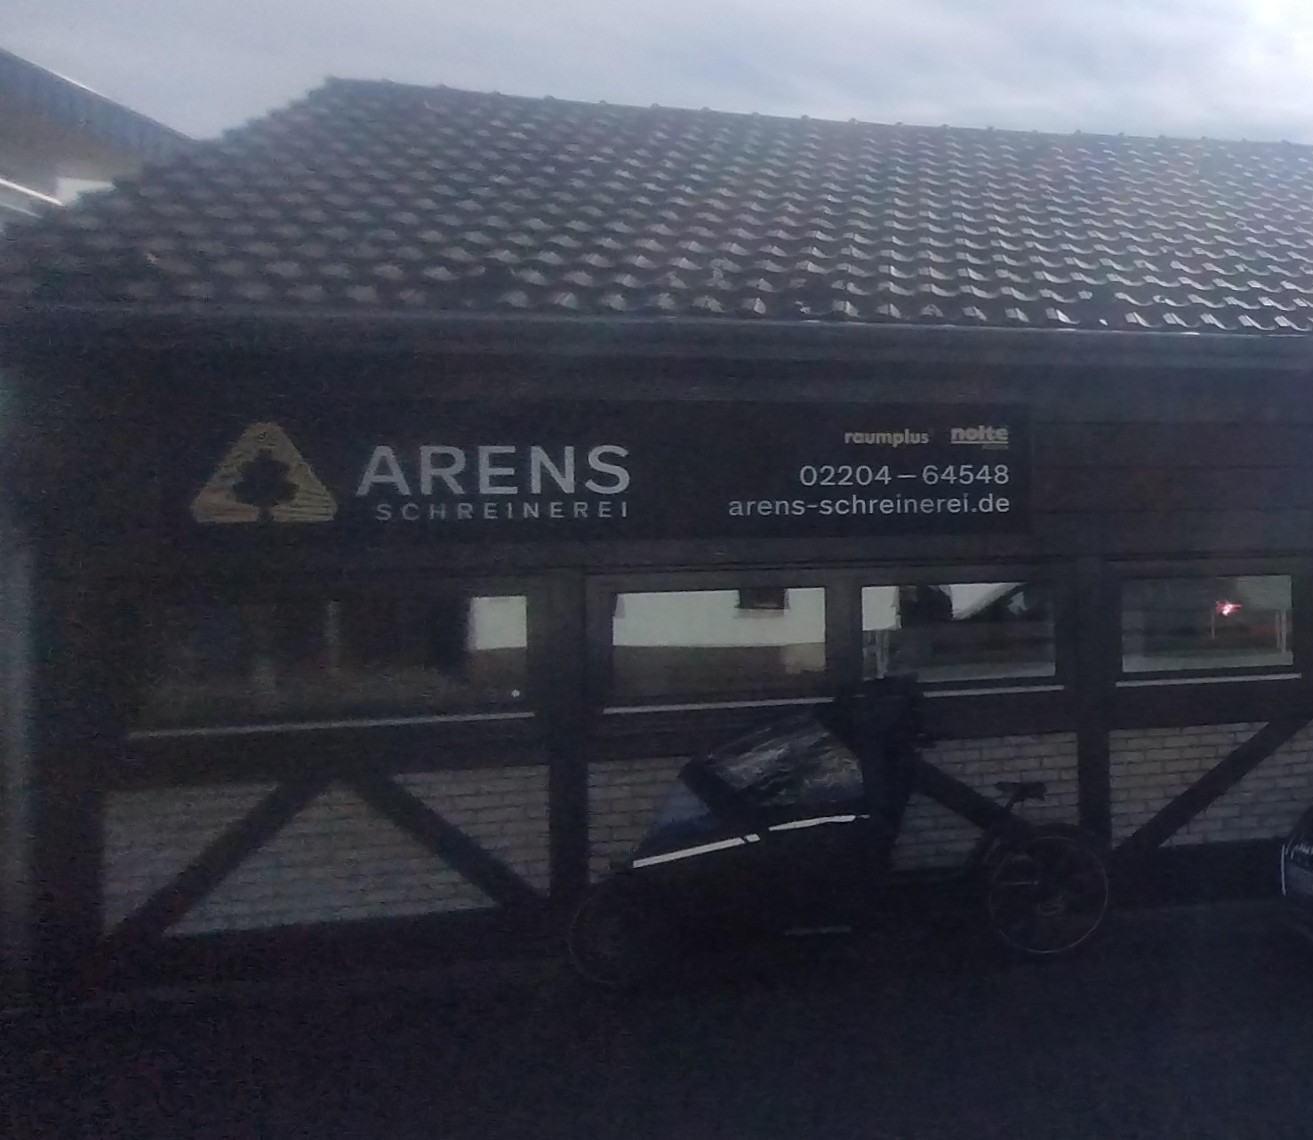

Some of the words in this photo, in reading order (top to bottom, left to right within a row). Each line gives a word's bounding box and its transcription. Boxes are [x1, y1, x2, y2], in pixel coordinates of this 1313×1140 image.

[844, 429, 929, 447] raumplus
[951, 425, 1008, 440] nolte
[356, 445, 630, 496] ARENS
[800, 465, 891, 486] 02204
[922, 464, 1009, 485] 64548
[375, 501, 629, 521] SCHREINEREI
[728, 494, 1010, 516] arens-schreinerei.de
